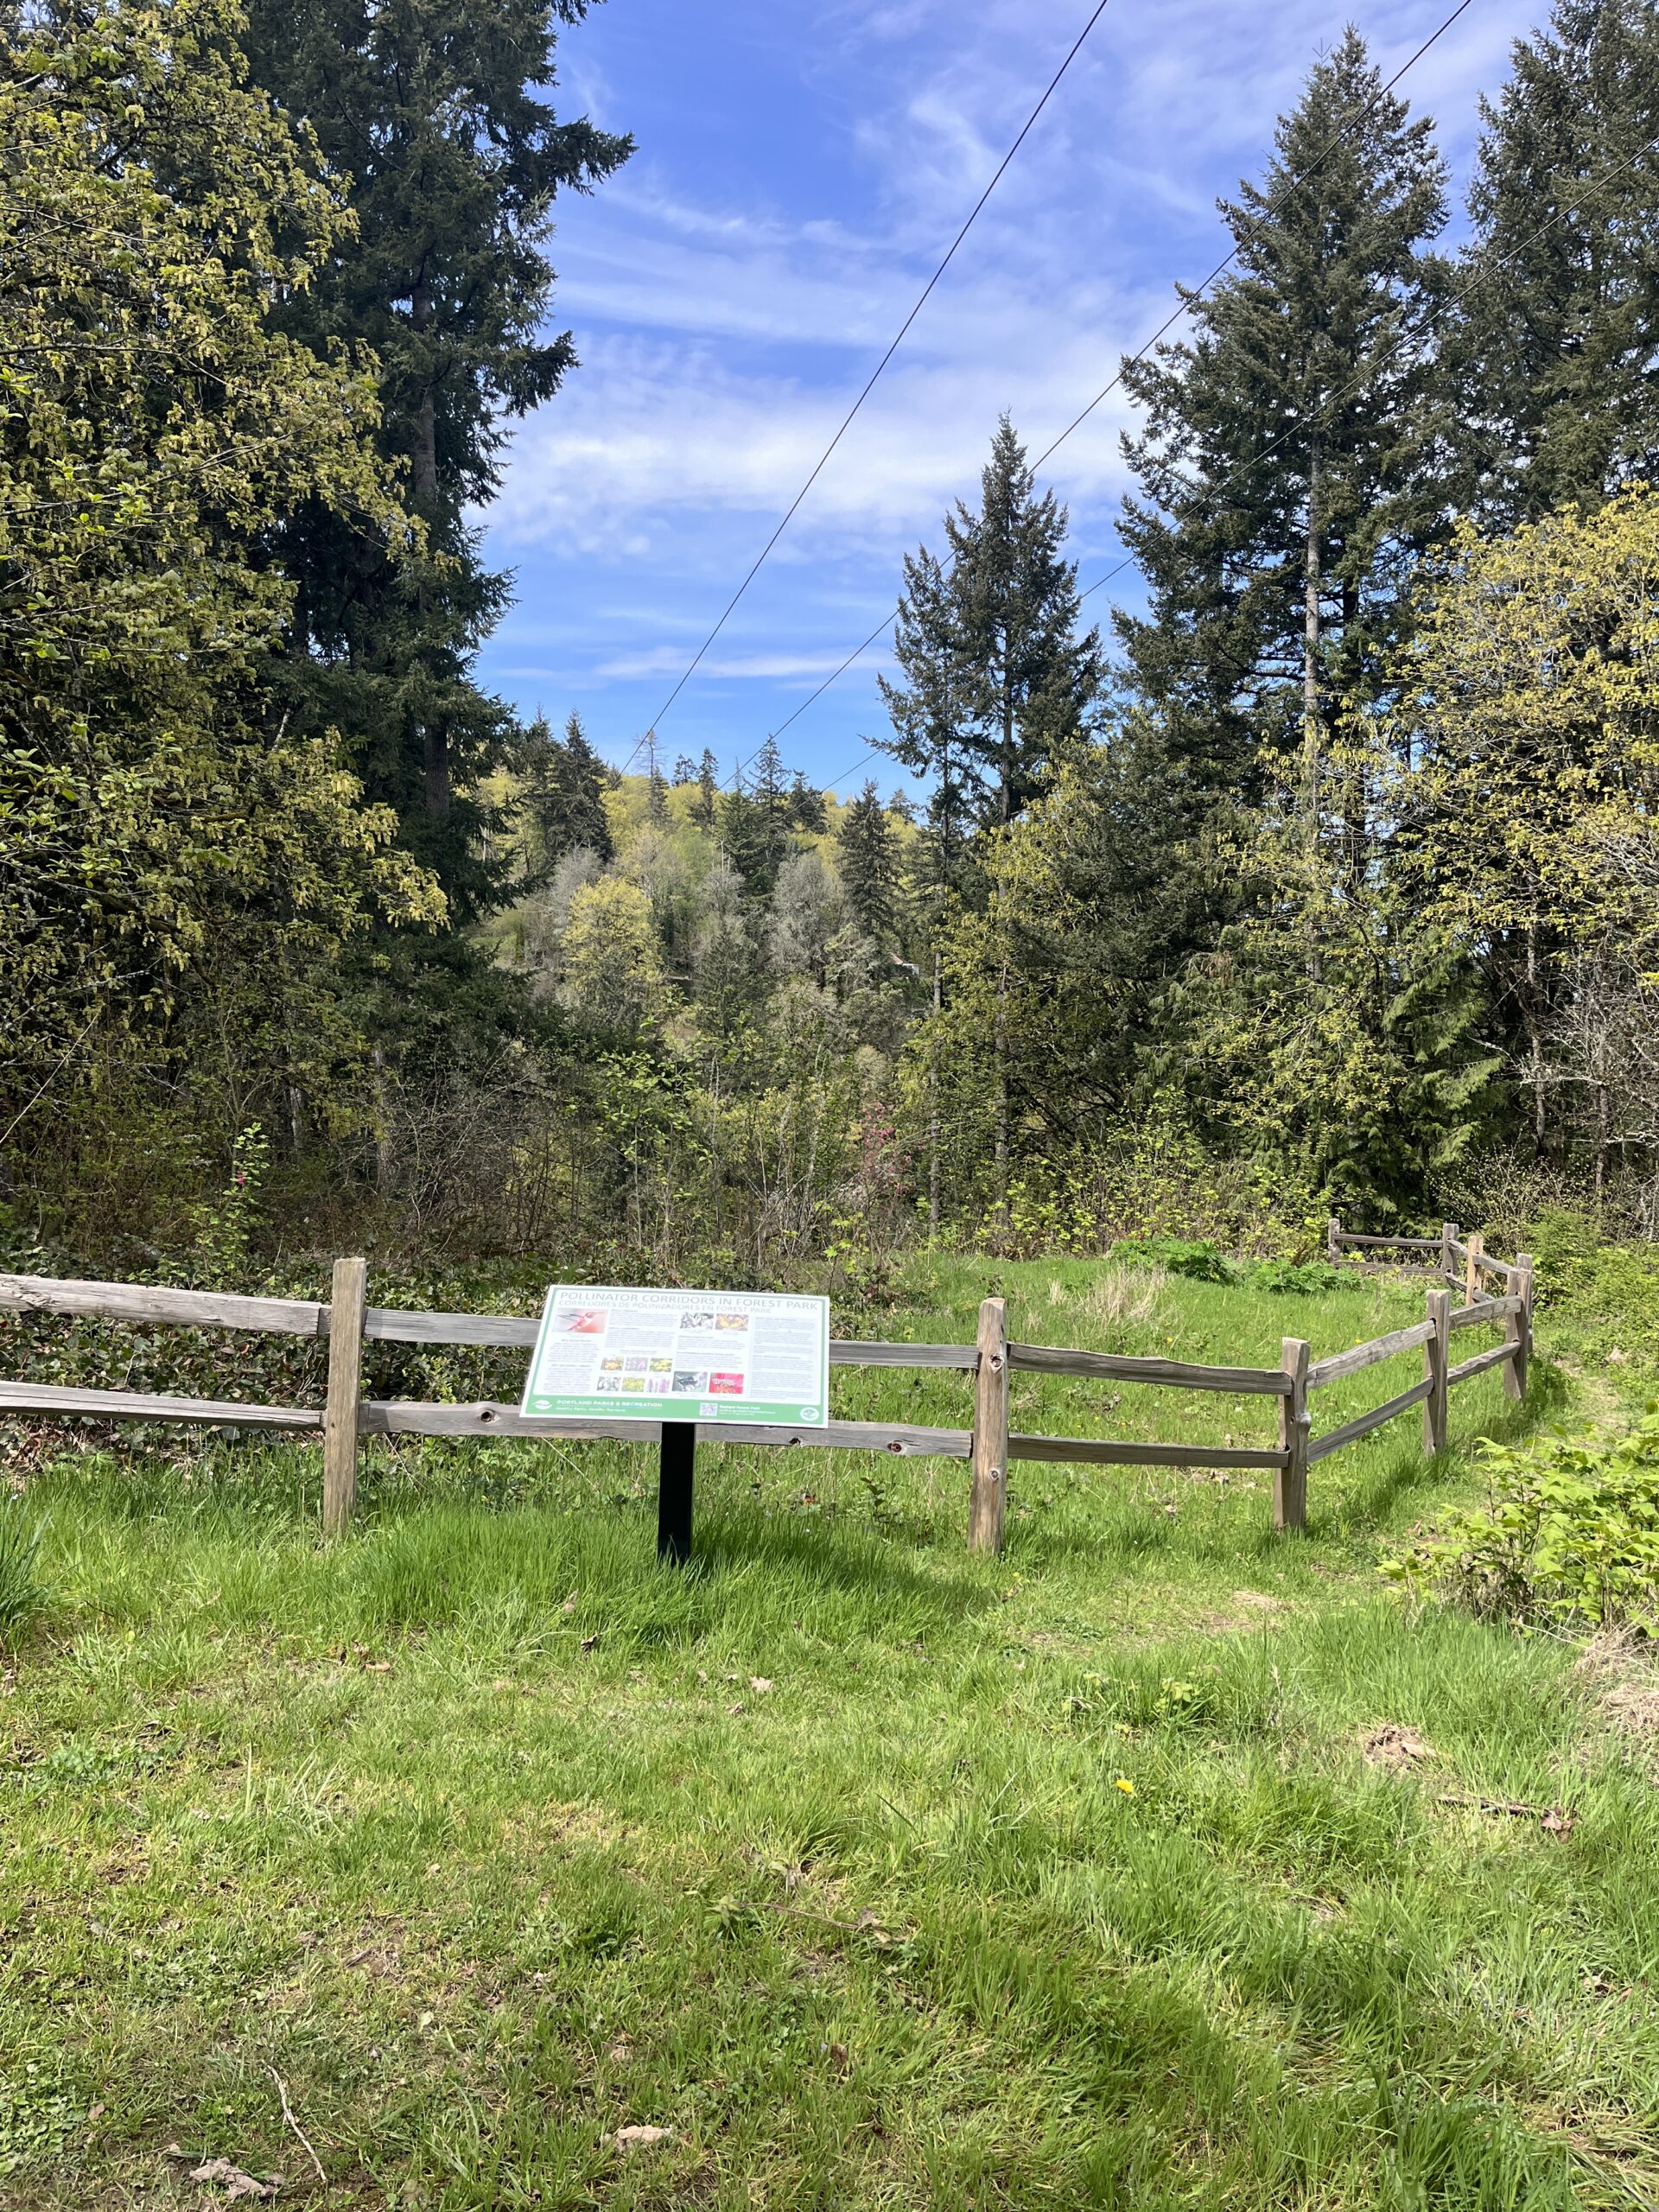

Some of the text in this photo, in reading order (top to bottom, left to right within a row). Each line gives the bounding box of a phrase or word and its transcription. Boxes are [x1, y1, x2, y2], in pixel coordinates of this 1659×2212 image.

[559, 1300, 616, 1308] CORREDORES
[632, 1302, 700, 1311] POLINIZADORES
[560, 1292, 818, 1311] POLLINATOR CORRIDORS IN FOREST PARK
